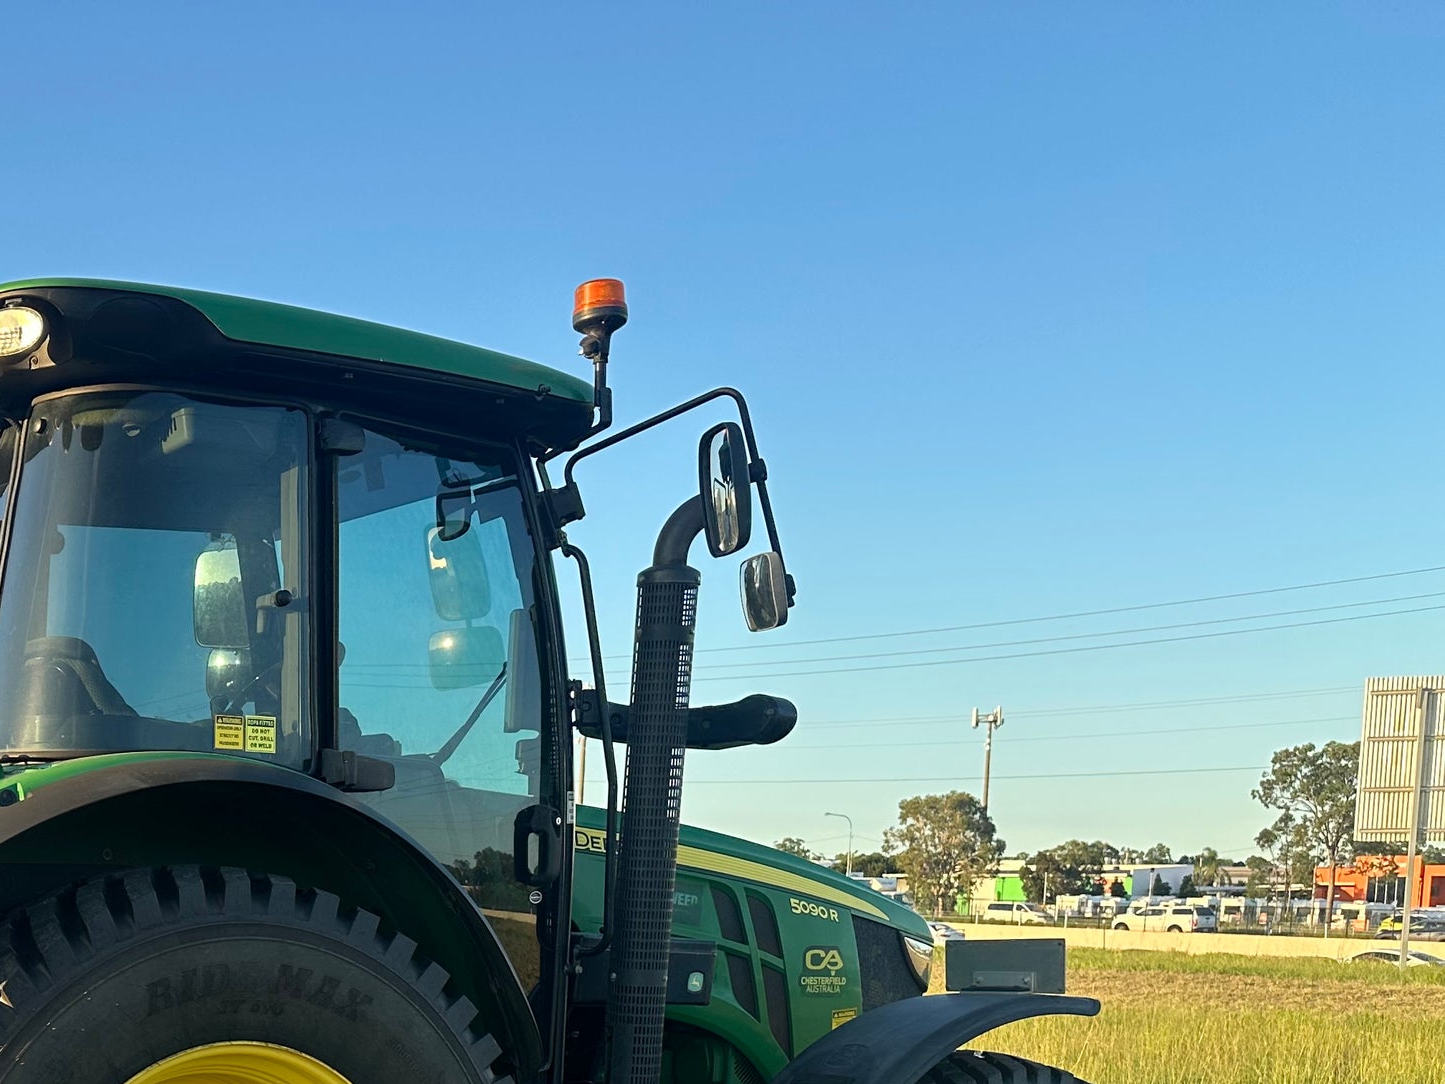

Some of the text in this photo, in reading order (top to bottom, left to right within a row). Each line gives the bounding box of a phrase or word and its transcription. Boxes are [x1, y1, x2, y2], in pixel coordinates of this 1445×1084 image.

[575, 831, 607, 850] DE
[789, 897, 840, 922] 5090 R
[800, 976, 847, 986] CHESTERFIELD
[806, 984, 841, 994] AUSTRALIA
